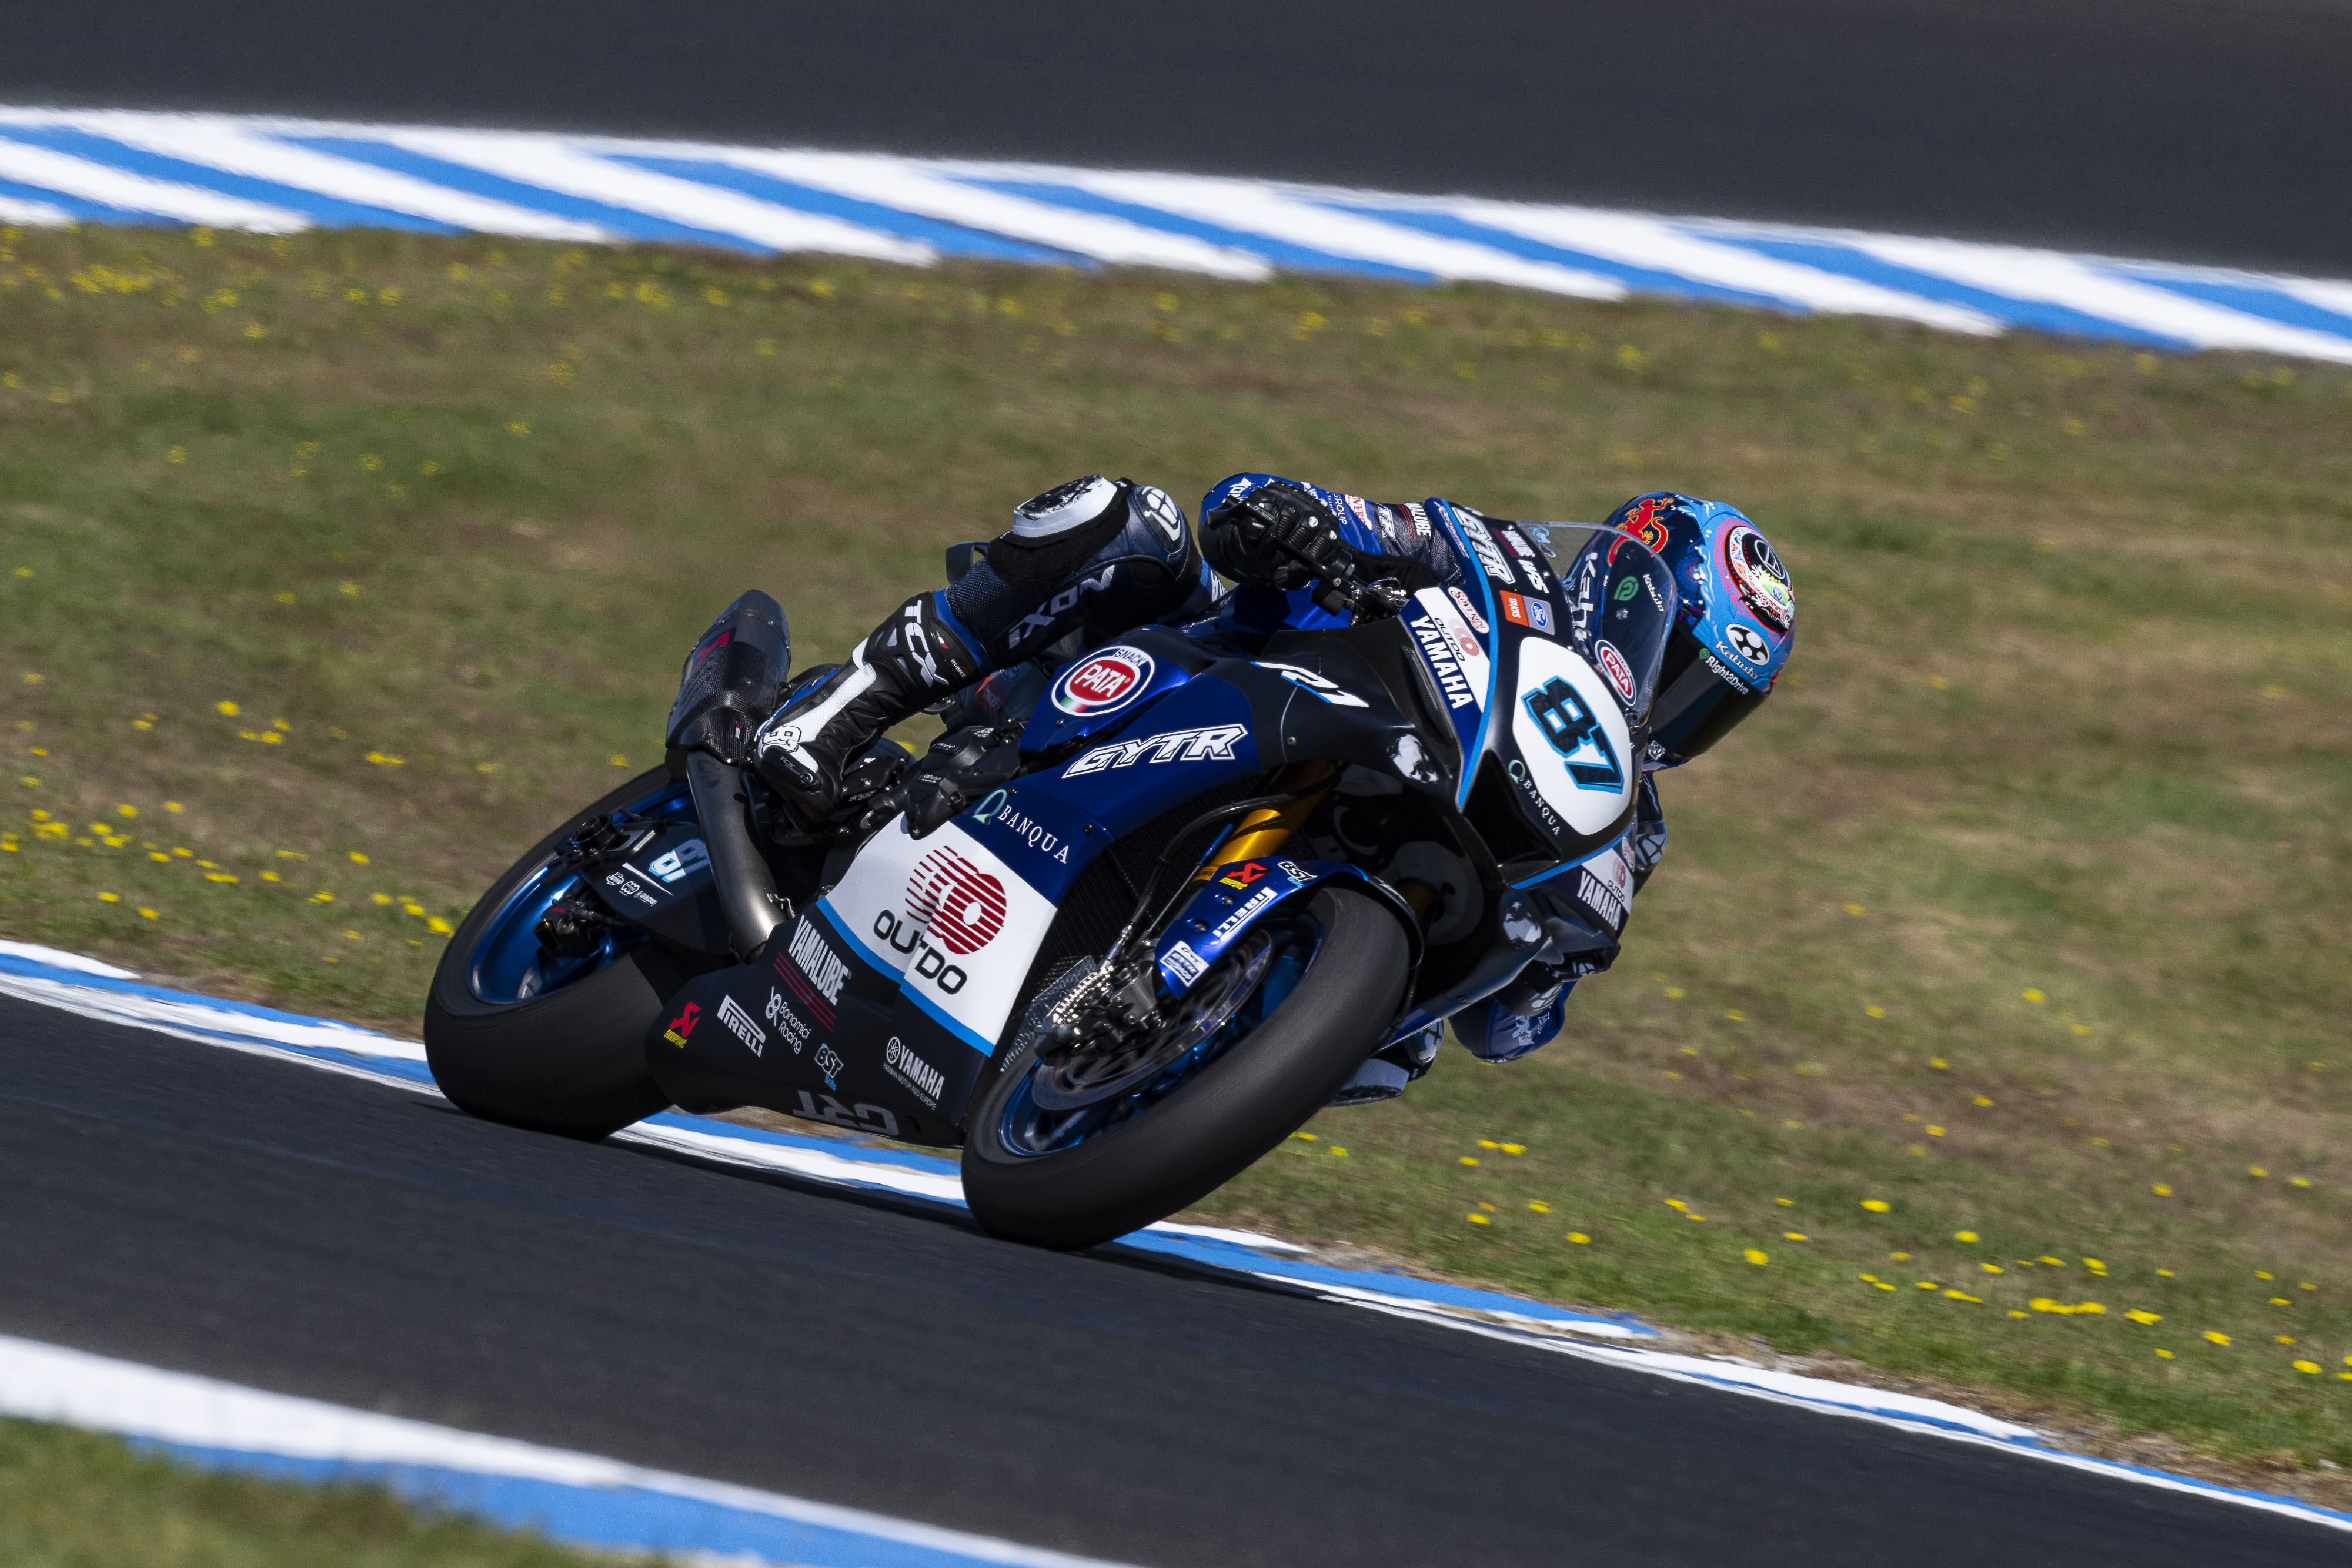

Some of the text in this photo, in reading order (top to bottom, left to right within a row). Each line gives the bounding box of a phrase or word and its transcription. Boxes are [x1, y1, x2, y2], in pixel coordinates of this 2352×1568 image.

[1451, 507, 1516, 584] GYTR
[1507, 597, 1522, 618] TRUCKS
[1532, 604, 1546, 624] Ford
[904, 600, 950, 688] TCX
[1114, 648, 1146, 667] SNACK
[1434, 617, 1465, 661] OUTDO
[1715, 640, 1759, 680] Kabuto
[1074, 664, 1127, 697] PATA
[1410, 615, 1474, 710] YAMAHA
[1605, 652, 1629, 692] PATA
[1705, 655, 1749, 695] Right2Drive
[1061, 724, 1248, 779] GYTR
[1521, 675, 1625, 795] 87
[1522, 779, 1561, 835] BANQUA
[997, 804, 1069, 864] BANQUA
[1277, 861, 1318, 882] BST
[1608, 880, 1625, 902] OUTDO
[1212, 887, 1278, 941] PIRELLI
[1576, 870, 1622, 931] YAMAHA
[789, 915, 848, 1005] YAMALUBE
[873, 909, 967, 995] OUTDO
[717, 994, 766, 1058] PIRELLI
[779, 1001, 811, 1039] Bonamici
[779, 1021, 802, 1054] Racing
[814, 1043, 844, 1078] BST
[898, 1044, 944, 1100] YAMAHA
[792, 1090, 900, 1136] GRT
[920, 1092, 937, 1111] EUROPE
